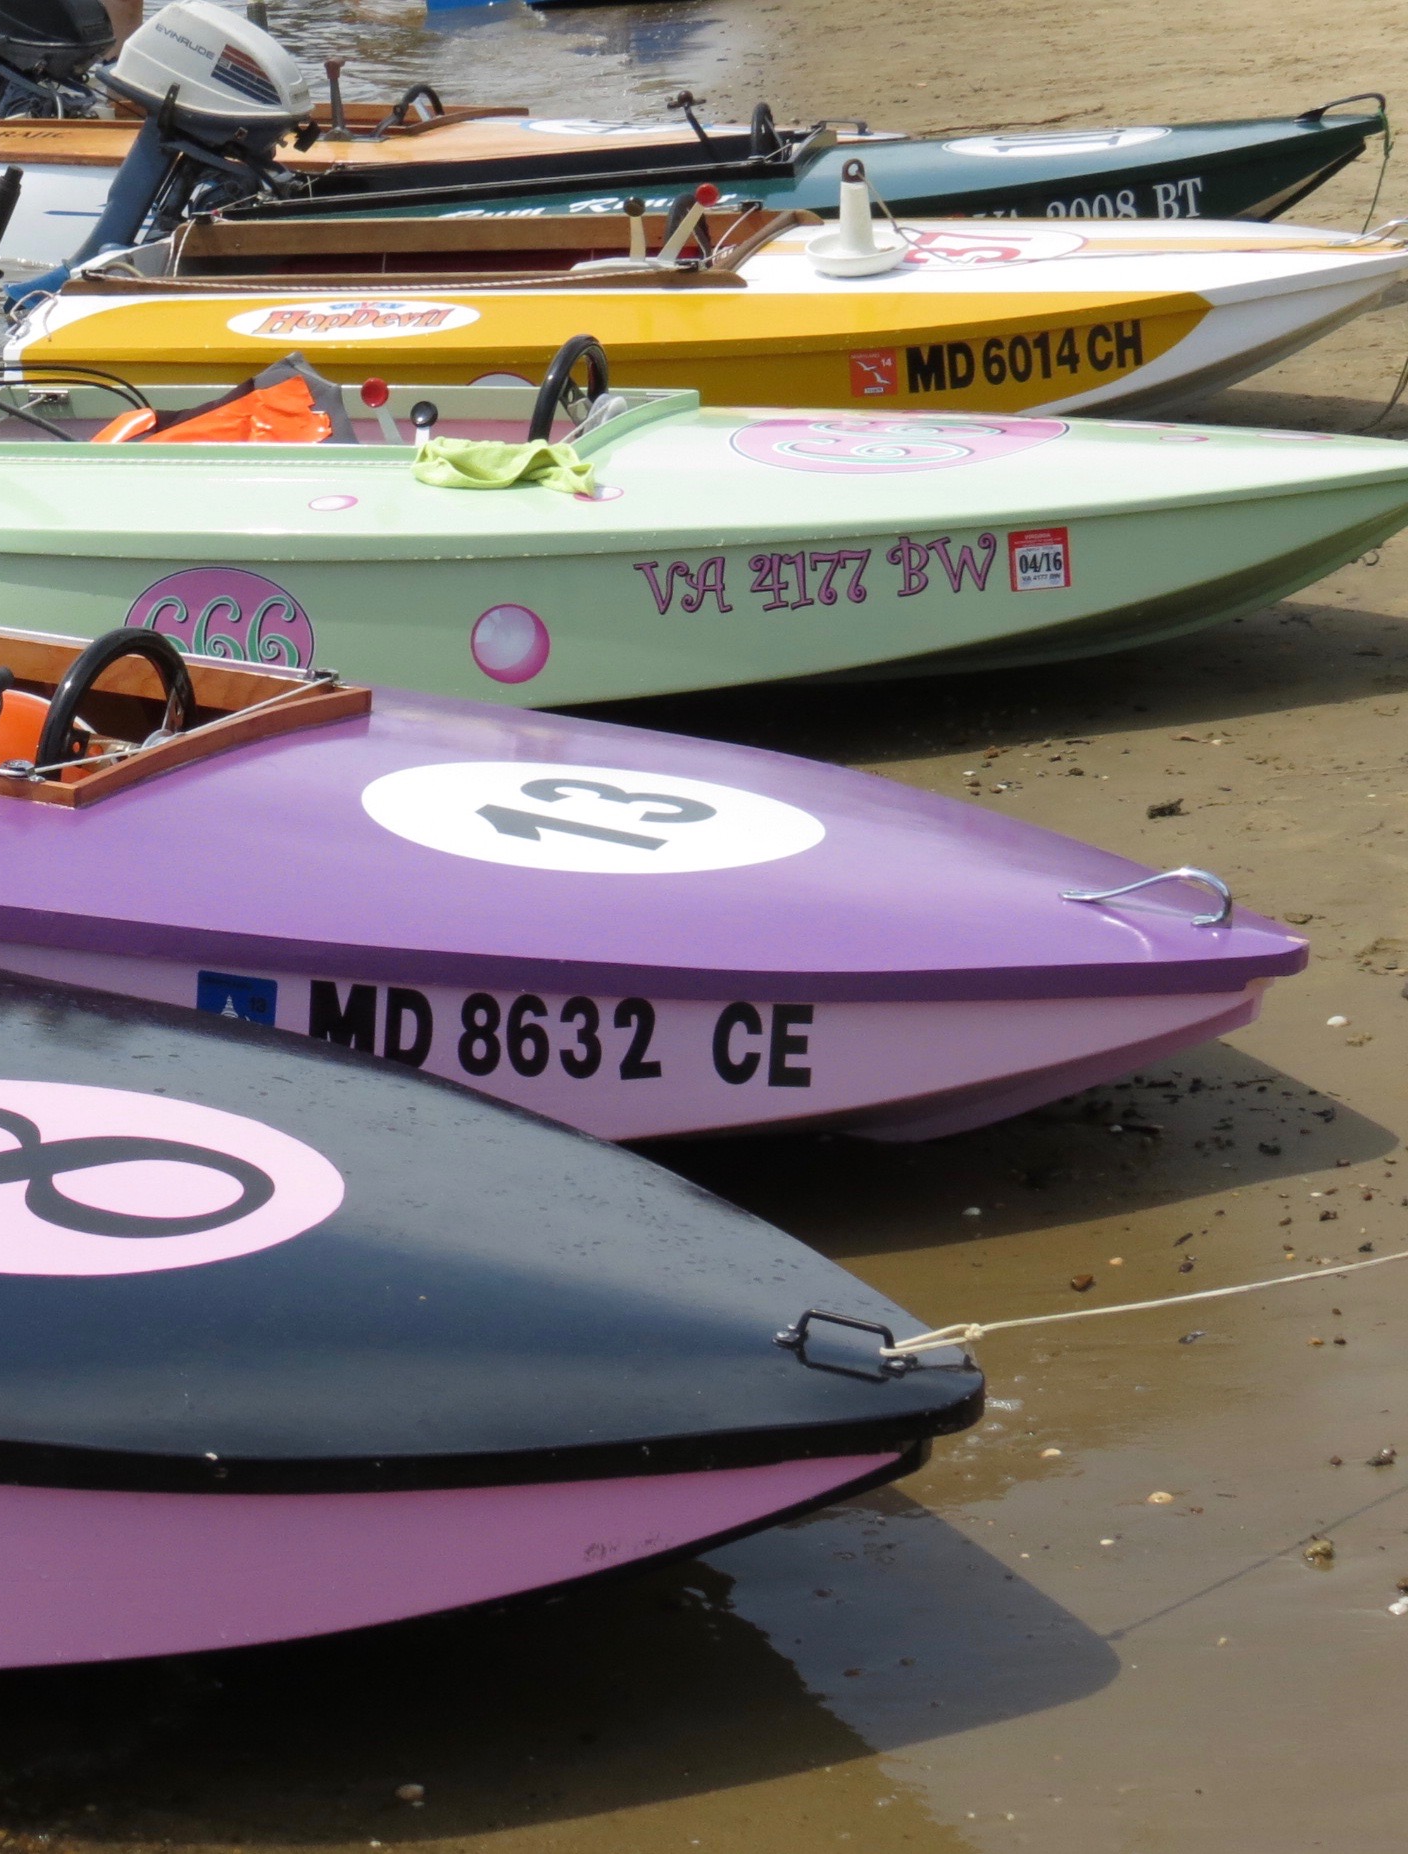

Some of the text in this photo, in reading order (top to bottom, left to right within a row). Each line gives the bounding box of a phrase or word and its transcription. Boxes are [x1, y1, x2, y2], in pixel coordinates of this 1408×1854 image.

[154, 22, 216, 61] EVINRUDE
[1152, 177, 1203, 219] BT
[250, 307, 456, 336] HopDevil
[905, 318, 1143, 394] MD 6014 CH
[633, 532, 997, 615] VA 4177 BW
[1018, 551, 1063, 574] 04/16
[474, 778, 718, 851] 13
[309, 979, 814, 1088] MD 8632 CE
